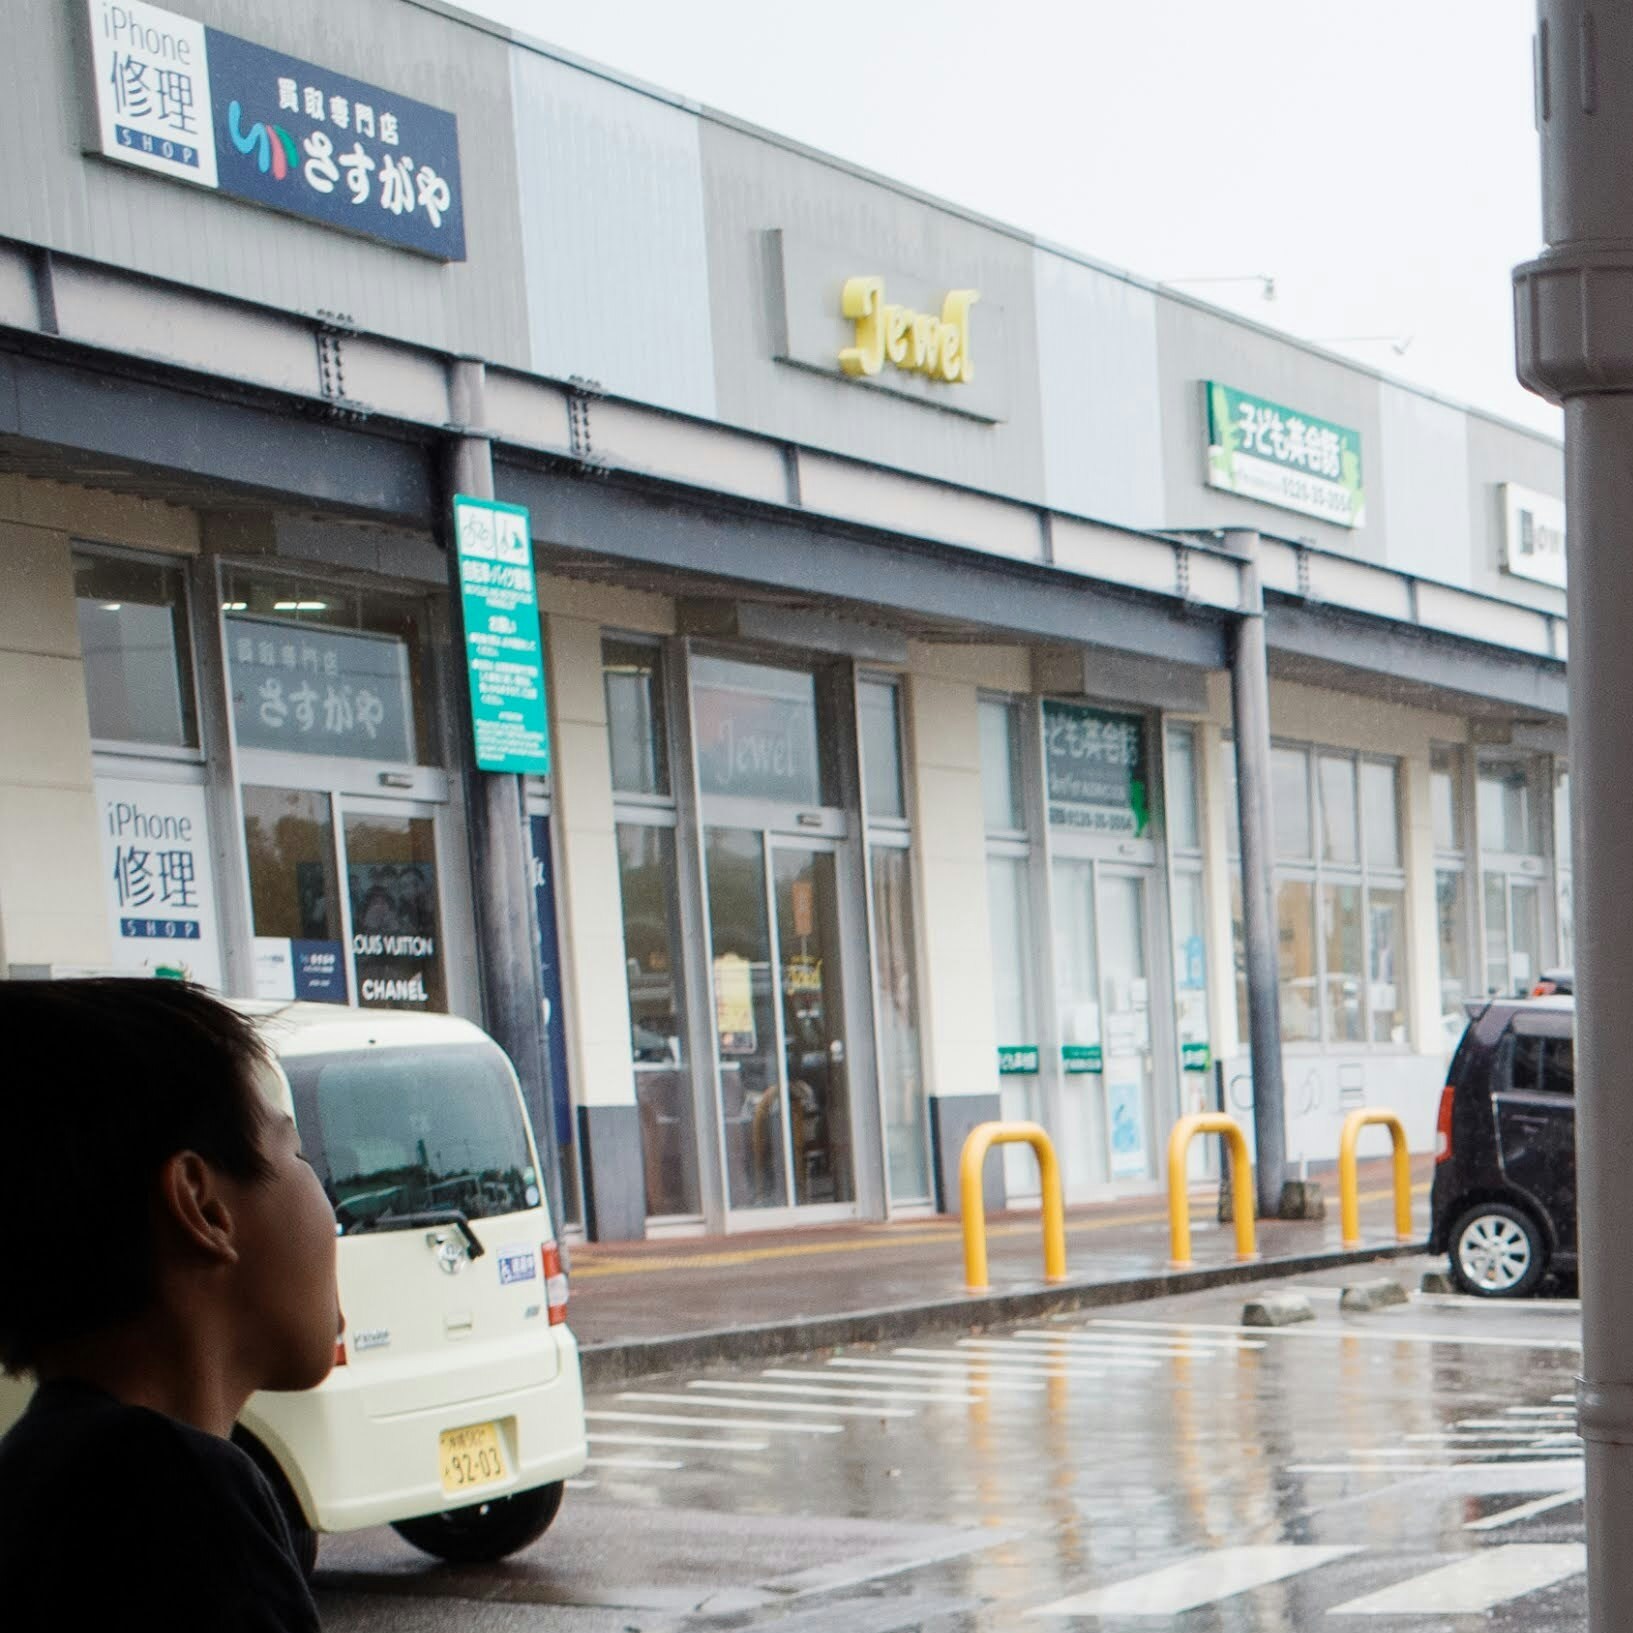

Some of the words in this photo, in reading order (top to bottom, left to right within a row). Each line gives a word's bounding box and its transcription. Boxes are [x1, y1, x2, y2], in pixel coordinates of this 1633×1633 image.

[104, 3, 191, 66] iPhone
[111, 50, 198, 136] 修理
[277, 77, 400, 146] 買取専門店
[303, 130, 451, 229] さすがや
[838, 276, 982, 384] Jewel
[257, 677, 384, 739] さすがや
[714, 711, 799, 785] Jewel
[107, 801, 193, 843] iPhone
[112, 845, 199, 909] 修理
[383, 935, 434, 957] VUITTON
[362, 977, 429, 1001] CHANEL
[452, 1446, 502, 1484] 92-03
